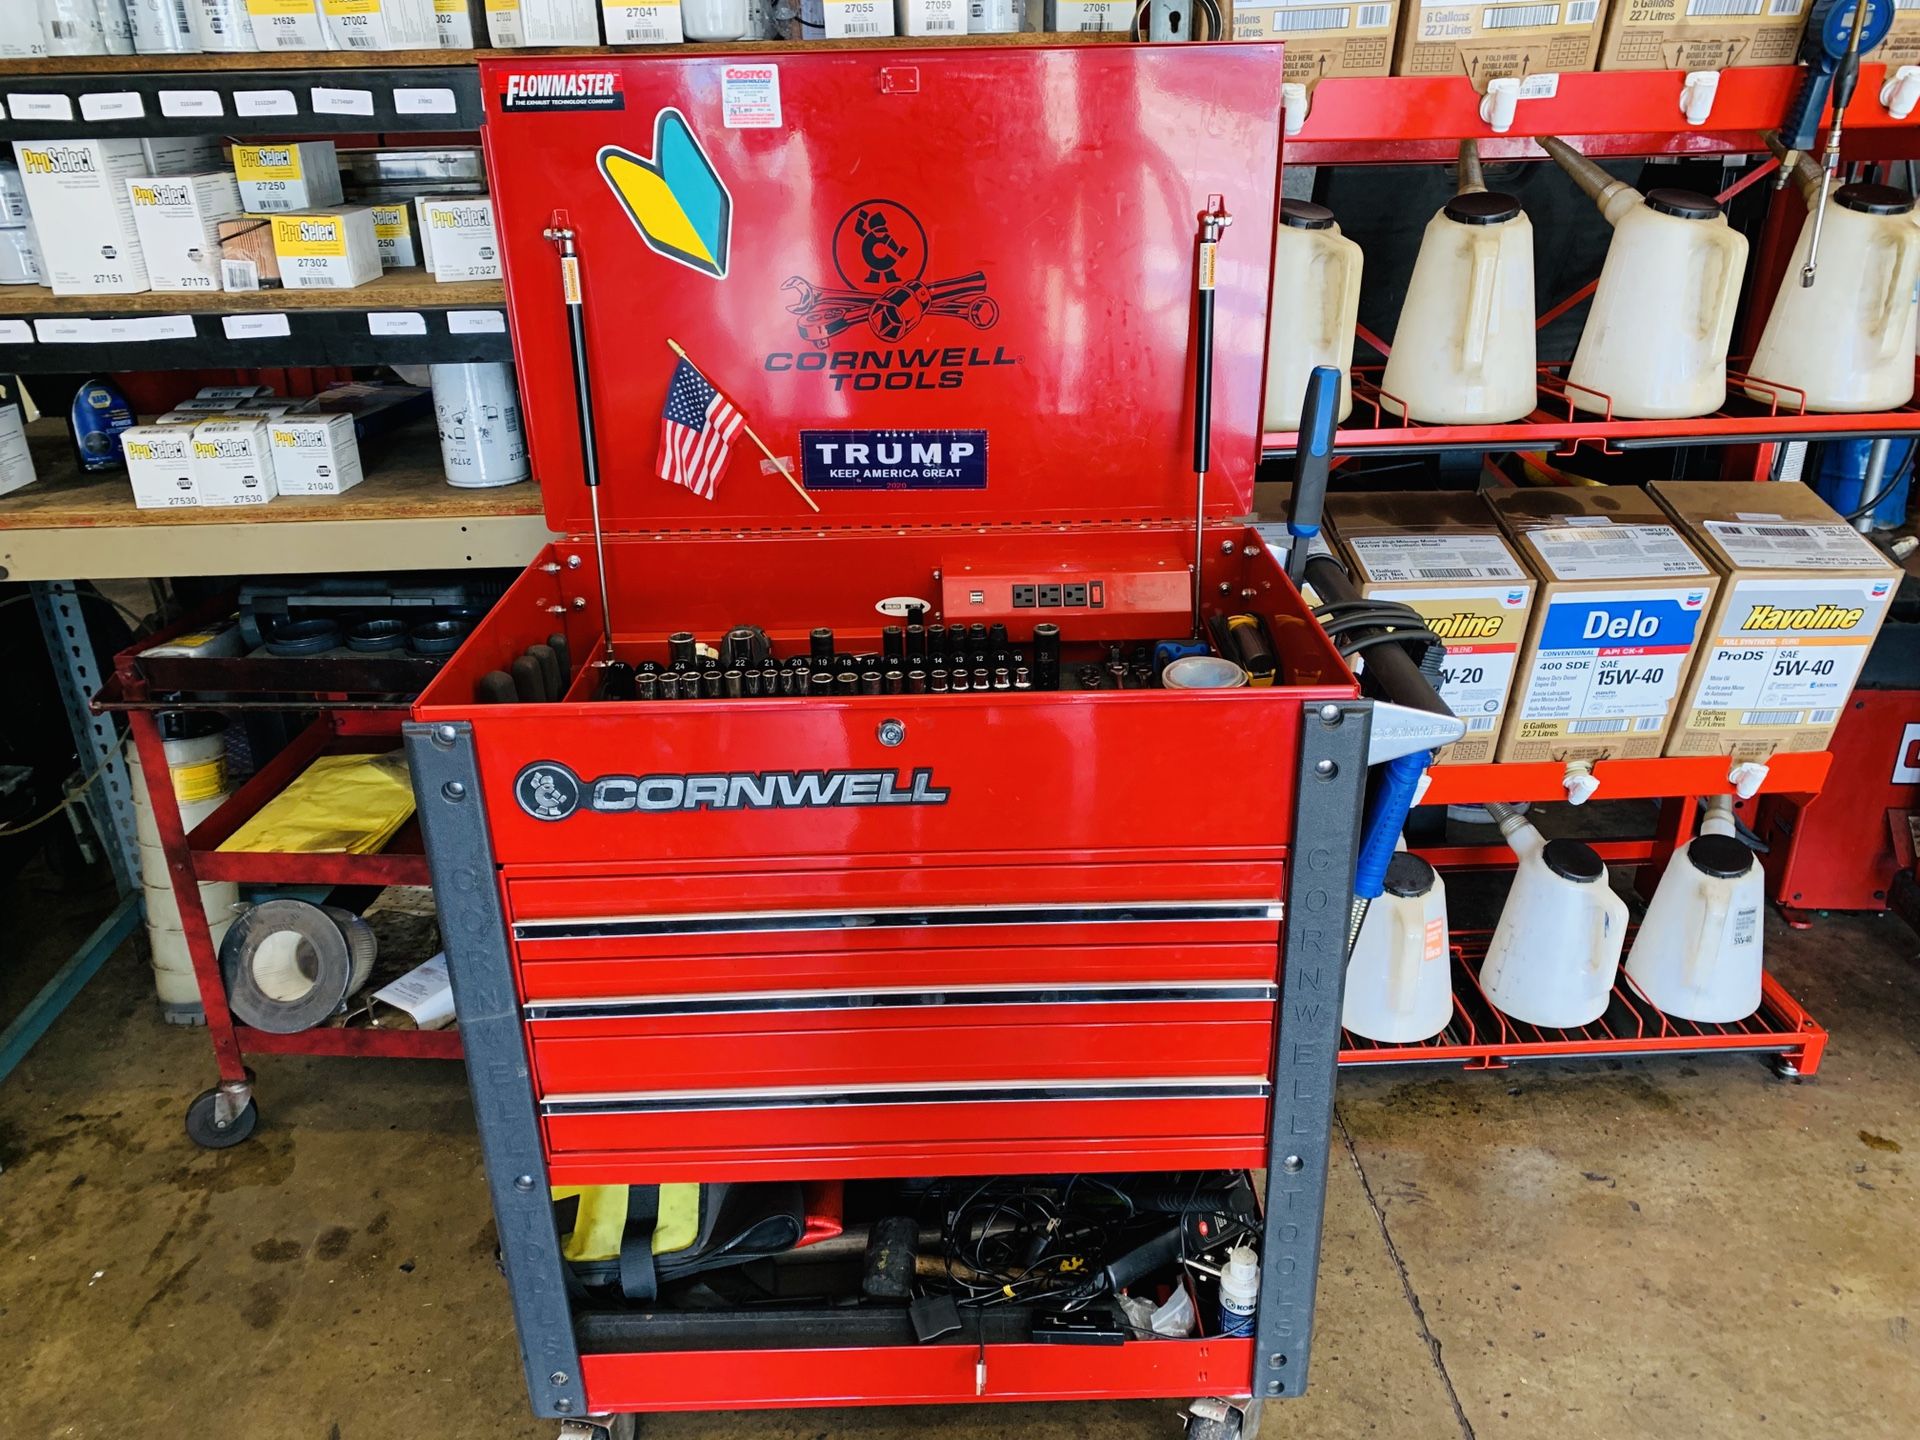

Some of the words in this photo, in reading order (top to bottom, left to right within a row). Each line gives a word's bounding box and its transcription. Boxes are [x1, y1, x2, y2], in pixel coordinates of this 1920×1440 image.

[844, 3, 874, 13] 27055
[925, 1, 952, 10] 27059
[1082, 3, 1111, 13] 27061
[626, 7, 658, 17] 27041
[1426, 12, 1433, 22] 6
[1434, 11, 1470, 22] Gallons
[1629, 11, 1648, 21] 22.7
[1649, 10, 1675, 20] Litres
[273, 17, 296, 25] 21626
[341, 16, 368, 26] 27002
[1233, 14, 1261, 24] allons
[1238, 26, 1263, 37] Litres
[1425, 25, 1444, 36] 22.7
[1445, 25, 1472, 35] Litres
[506, 73, 614, 106] FLOWMASTER
[21, 147, 96, 174] ProSelect
[241, 148, 293, 167] ProSelect
[256, 181, 286, 191] 27250
[132, 185, 191, 206] ProSelect
[431, 206, 490, 229] ProSelect
[278, 221, 338, 242] ProSelect
[297, 258, 328, 268] 27302
[468, 265, 497, 276] 27327
[93, 273, 123, 284] 27151
[181, 277, 210, 287] 27173
[764, 346, 1017, 372] CORNWELL
[828, 370, 964, 392] TOOLS
[273, 429, 327, 448] ProSelect
[128, 440, 187, 460] ProSelect
[193, 438, 251, 459] ProSelect
[815, 442, 975, 465] TRUMP
[830, 469, 860, 478] KEEP
[863, 469, 919, 478] AMERICA
[922, 468, 962, 478] GREAT
[307, 482, 334, 491] 21040
[168, 496, 197, 505] 27530
[233, 494, 263, 504] 27530
[1740, 604, 1864, 631] Havoline
[1583, 609, 1660, 640] Delo
[1543, 649, 1594, 657] CONVENTIONAL
[1717, 650, 1764, 661] ProDS
[1779, 650, 1800, 659] SAE
[705, 660, 716, 668] 23
[735, 659, 745, 667] 22
[764, 659, 774, 667] 21
[913, 657, 921, 665] 15
[1539, 662, 1562, 670] 400
[1565, 661, 1591, 669] SDE
[1600, 660, 1619, 668] SAE
[644, 663, 654, 671] 25
[675, 663, 685, 671] 24
[1773, 659, 1835, 676] 5W-40
[1598, 667, 1664, 686] 15W-40
[592, 772, 948, 811] CORNWELL
[1291, 848, 1331, 1136] CORNWELL
[1237, 1304, 1256, 1312] KOB
